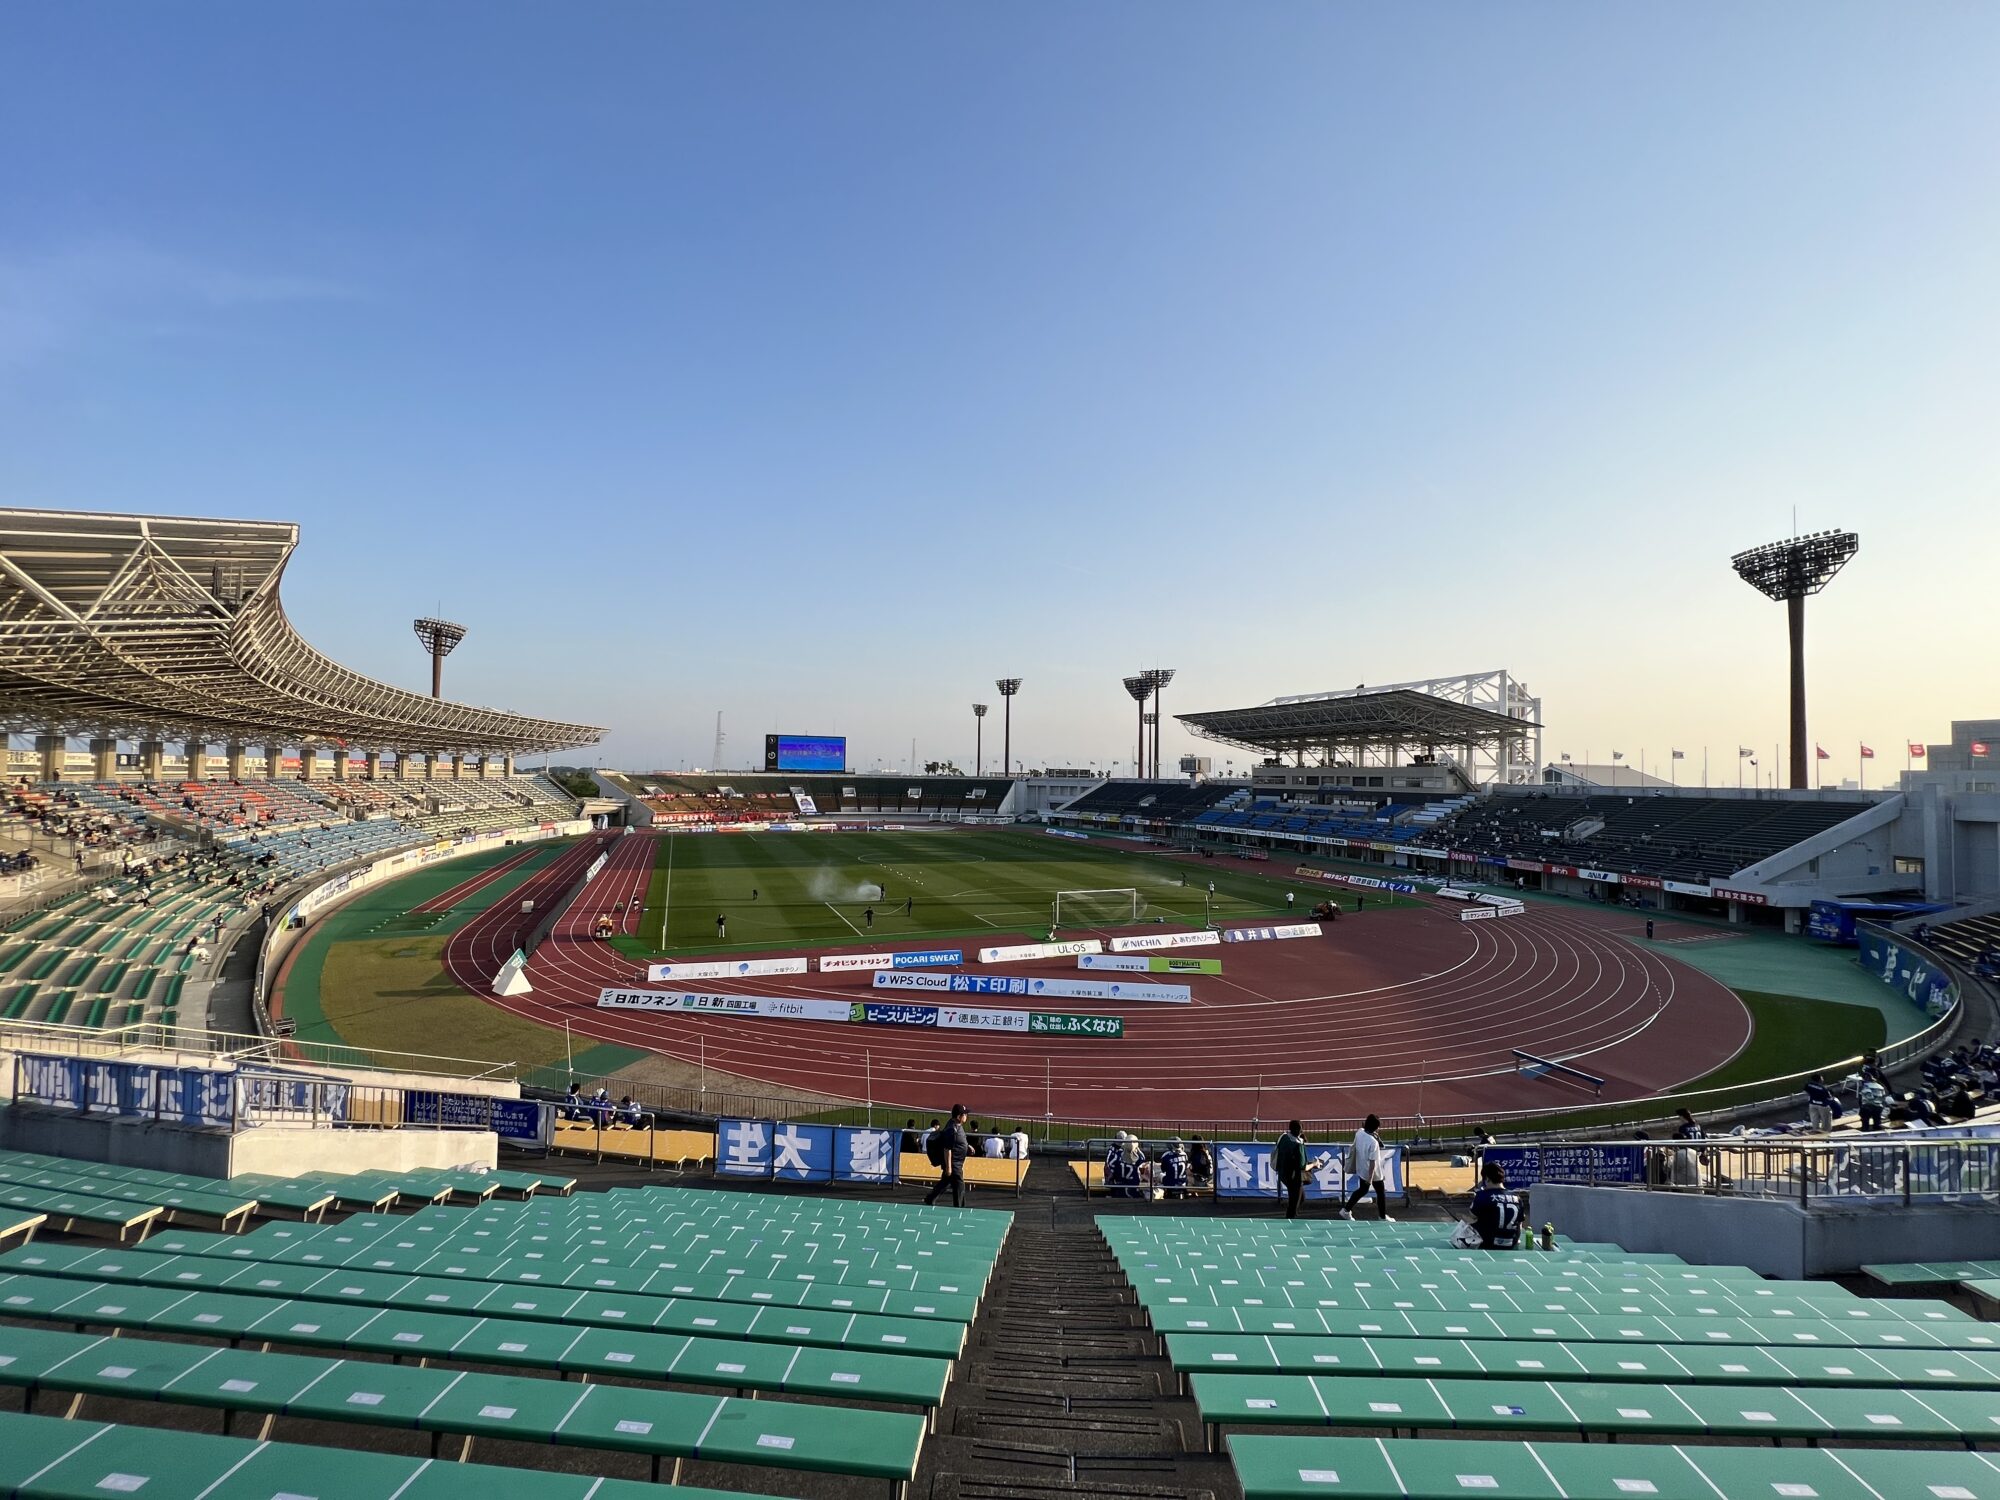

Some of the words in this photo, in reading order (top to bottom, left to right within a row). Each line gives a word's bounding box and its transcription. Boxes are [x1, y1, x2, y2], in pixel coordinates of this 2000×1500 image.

[1130, 938, 1162, 949] NICHIA
[895, 956, 928, 965] POCARI
[929, 953, 960, 963] SWEAT
[889, 975, 913, 985] WPS
[916, 976, 948, 987] Cloud
[953, 976, 1026, 994] 松下印刷
[615, 994, 678, 1006] 日本フネン
[698, 996, 725, 1008] 日新
[726, 1000, 757, 1010] 四国工場
[779, 1002, 803, 1014] fitbit
[867, 1009, 937, 1024] ピースリビング
[958, 1013, 1024, 1028] 徳島大正銀行
[1067, 1018, 1120, 1033] ふくなが
[1120, 1162, 1134, 1180] 12
[1171, 1162, 1187, 1180] 12
[1496, 1202, 1519, 1231] 12
